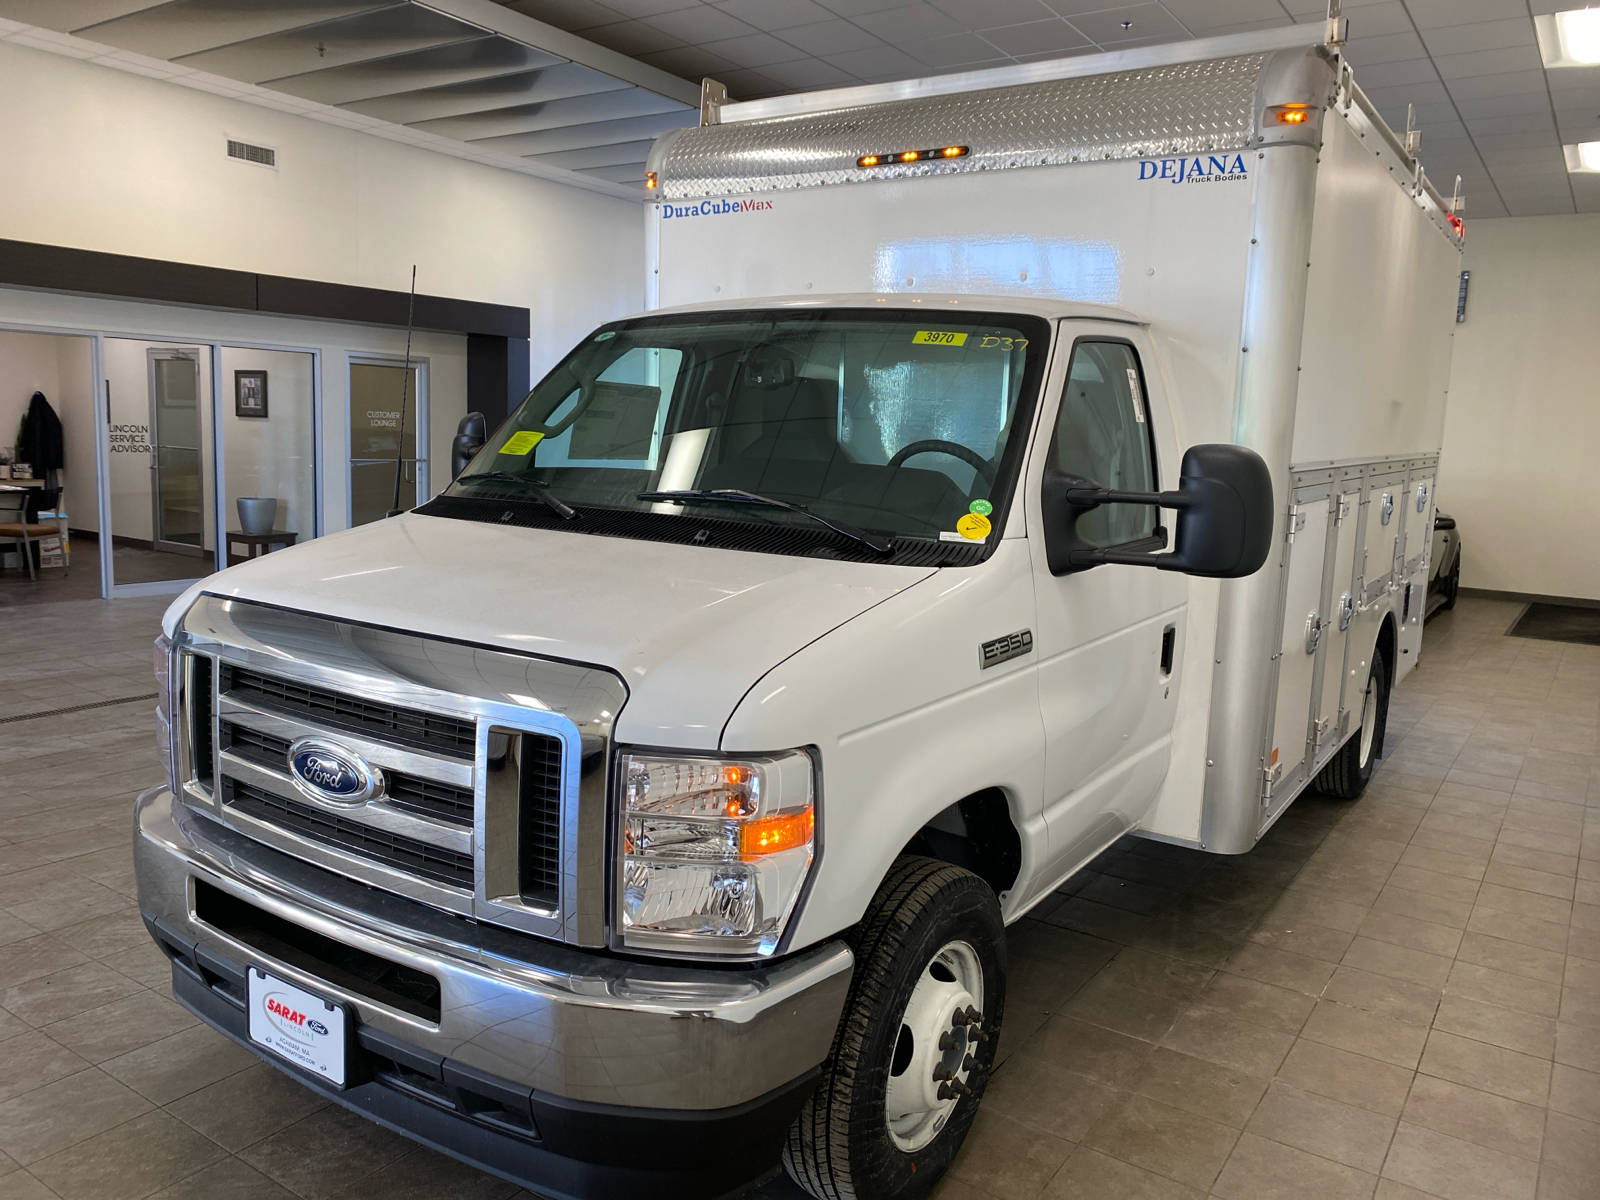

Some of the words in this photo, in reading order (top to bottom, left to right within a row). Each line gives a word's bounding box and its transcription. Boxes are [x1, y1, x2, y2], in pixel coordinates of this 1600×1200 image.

[1137, 154, 1248, 185] DEJANA
[1186, 175, 1212, 184] Truck
[1214, 173, 1248, 182] Bodies
[923, 332, 955, 343] 3970
[979, 335, 1030, 351] D37
[366, 410, 401, 419] CUSTOMER
[109, 424, 149, 433] LINCOLN
[370, 419, 397, 427] LOUNGE
[109, 434, 146, 443] SERVICE
[110, 444, 151, 453] ADVISOR
[303, 756, 342, 789] Ford
[267, 998, 306, 1026] SARAT
[310, 1020, 326, 1034] Ford
[284, 1021, 310, 1037] LINCOLN
